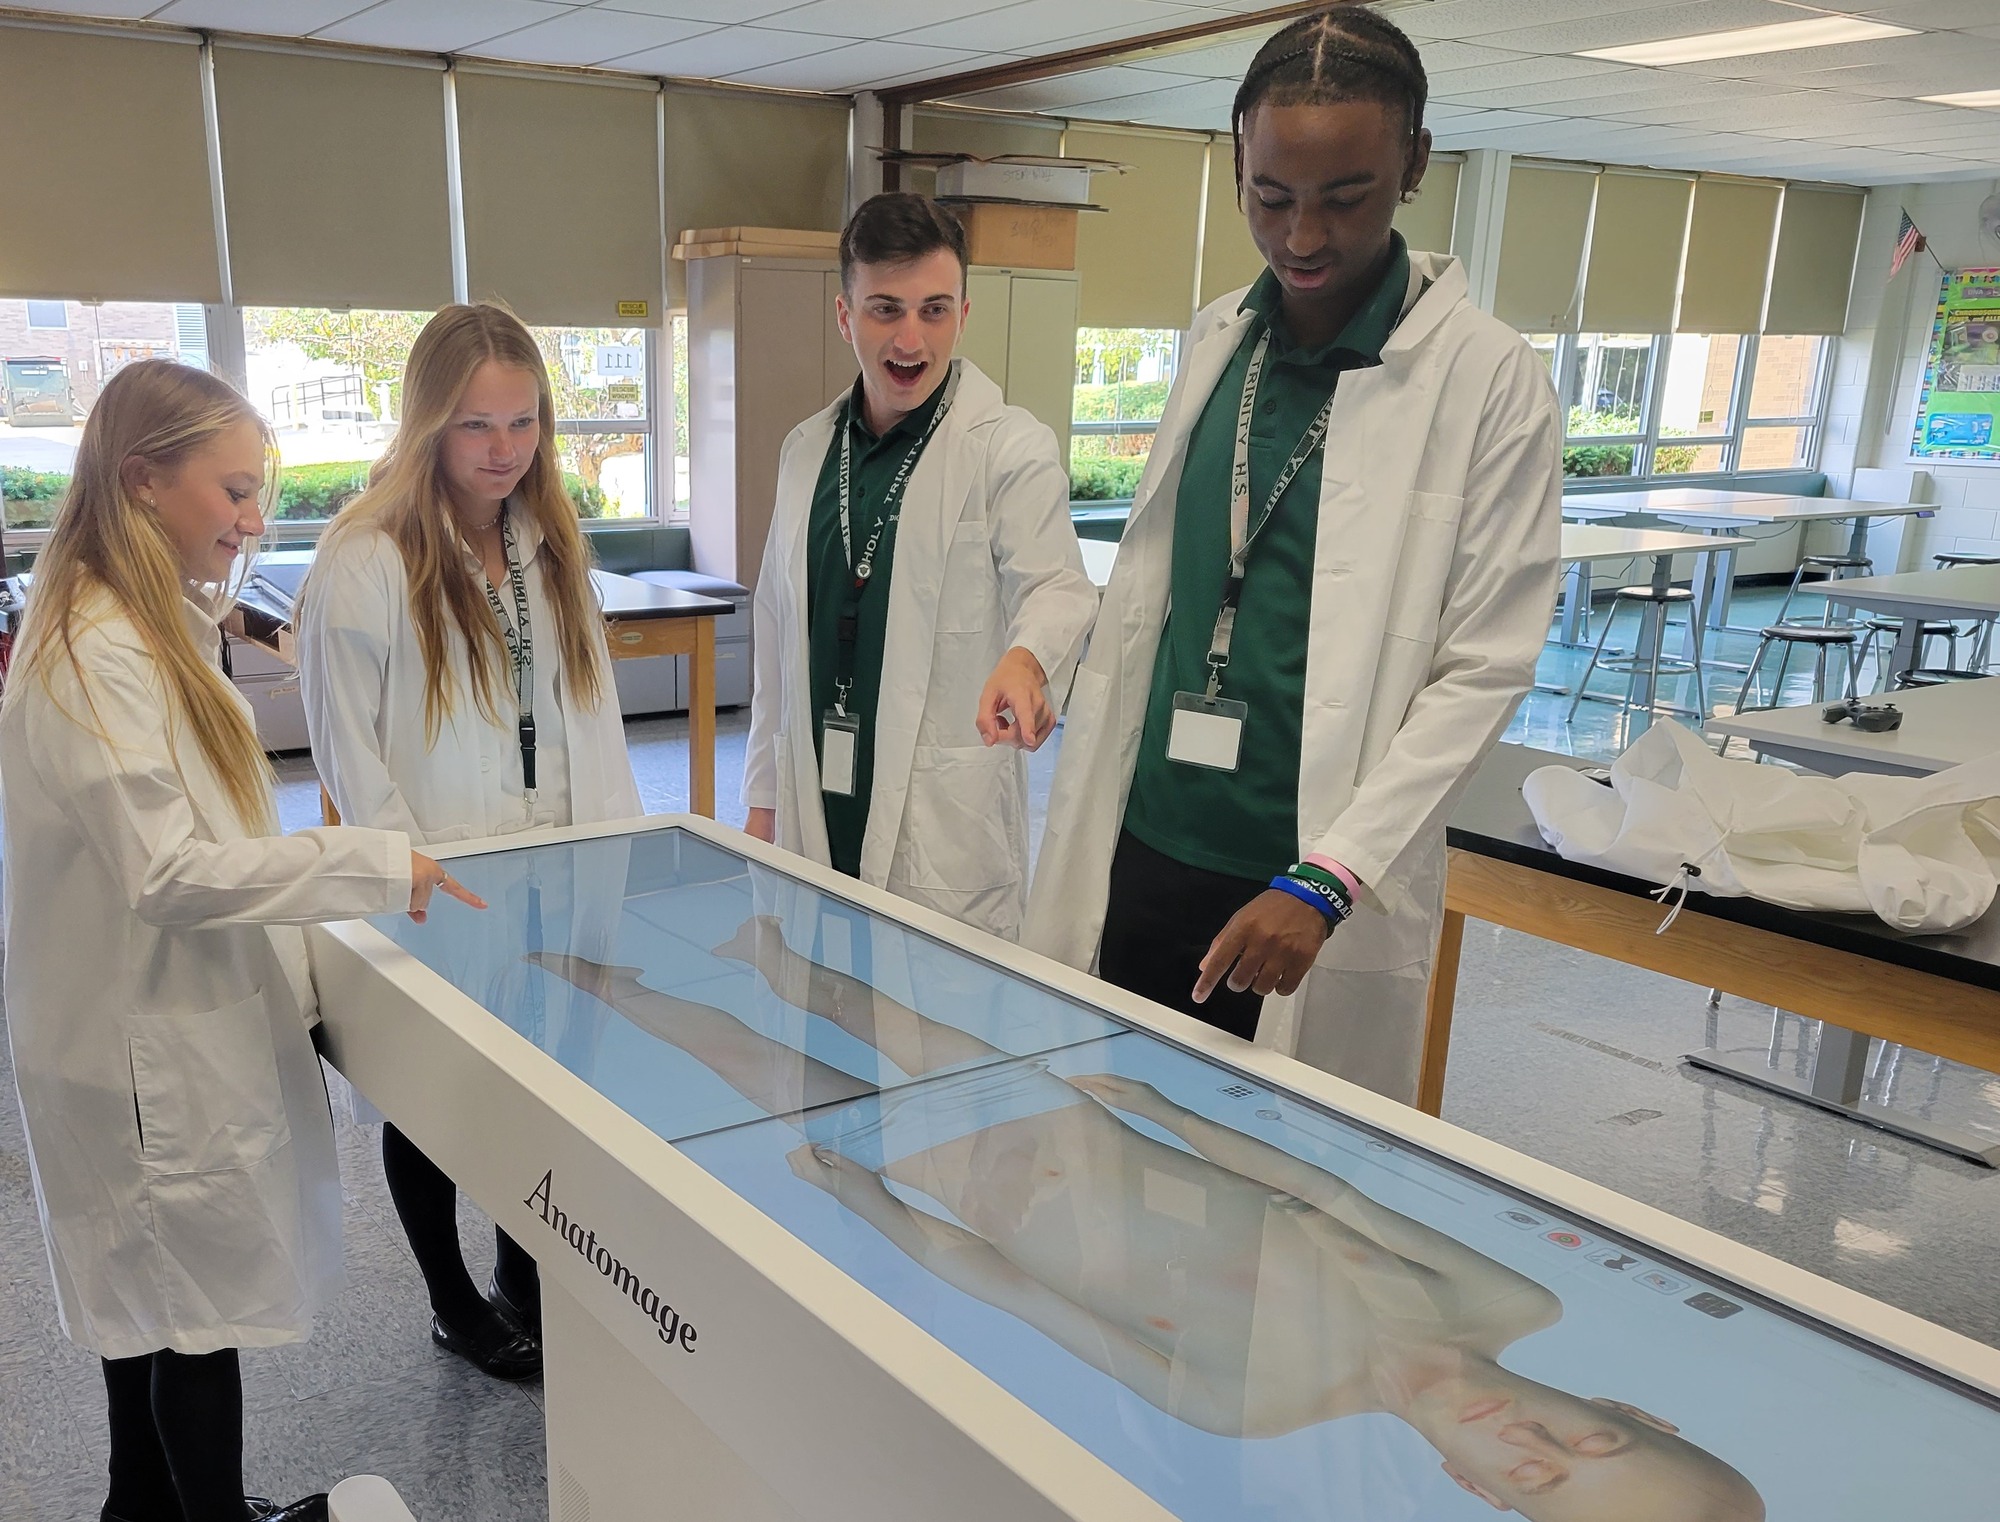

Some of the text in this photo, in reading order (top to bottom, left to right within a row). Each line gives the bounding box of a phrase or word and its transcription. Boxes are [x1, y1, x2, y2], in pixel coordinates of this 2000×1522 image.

[861, 516, 884, 563] HOLY
[883, 437, 925, 505] TRINITY
[1234, 356, 1262, 503] TRINITY H.S.
[522, 1168, 698, 1354] Anatomage
